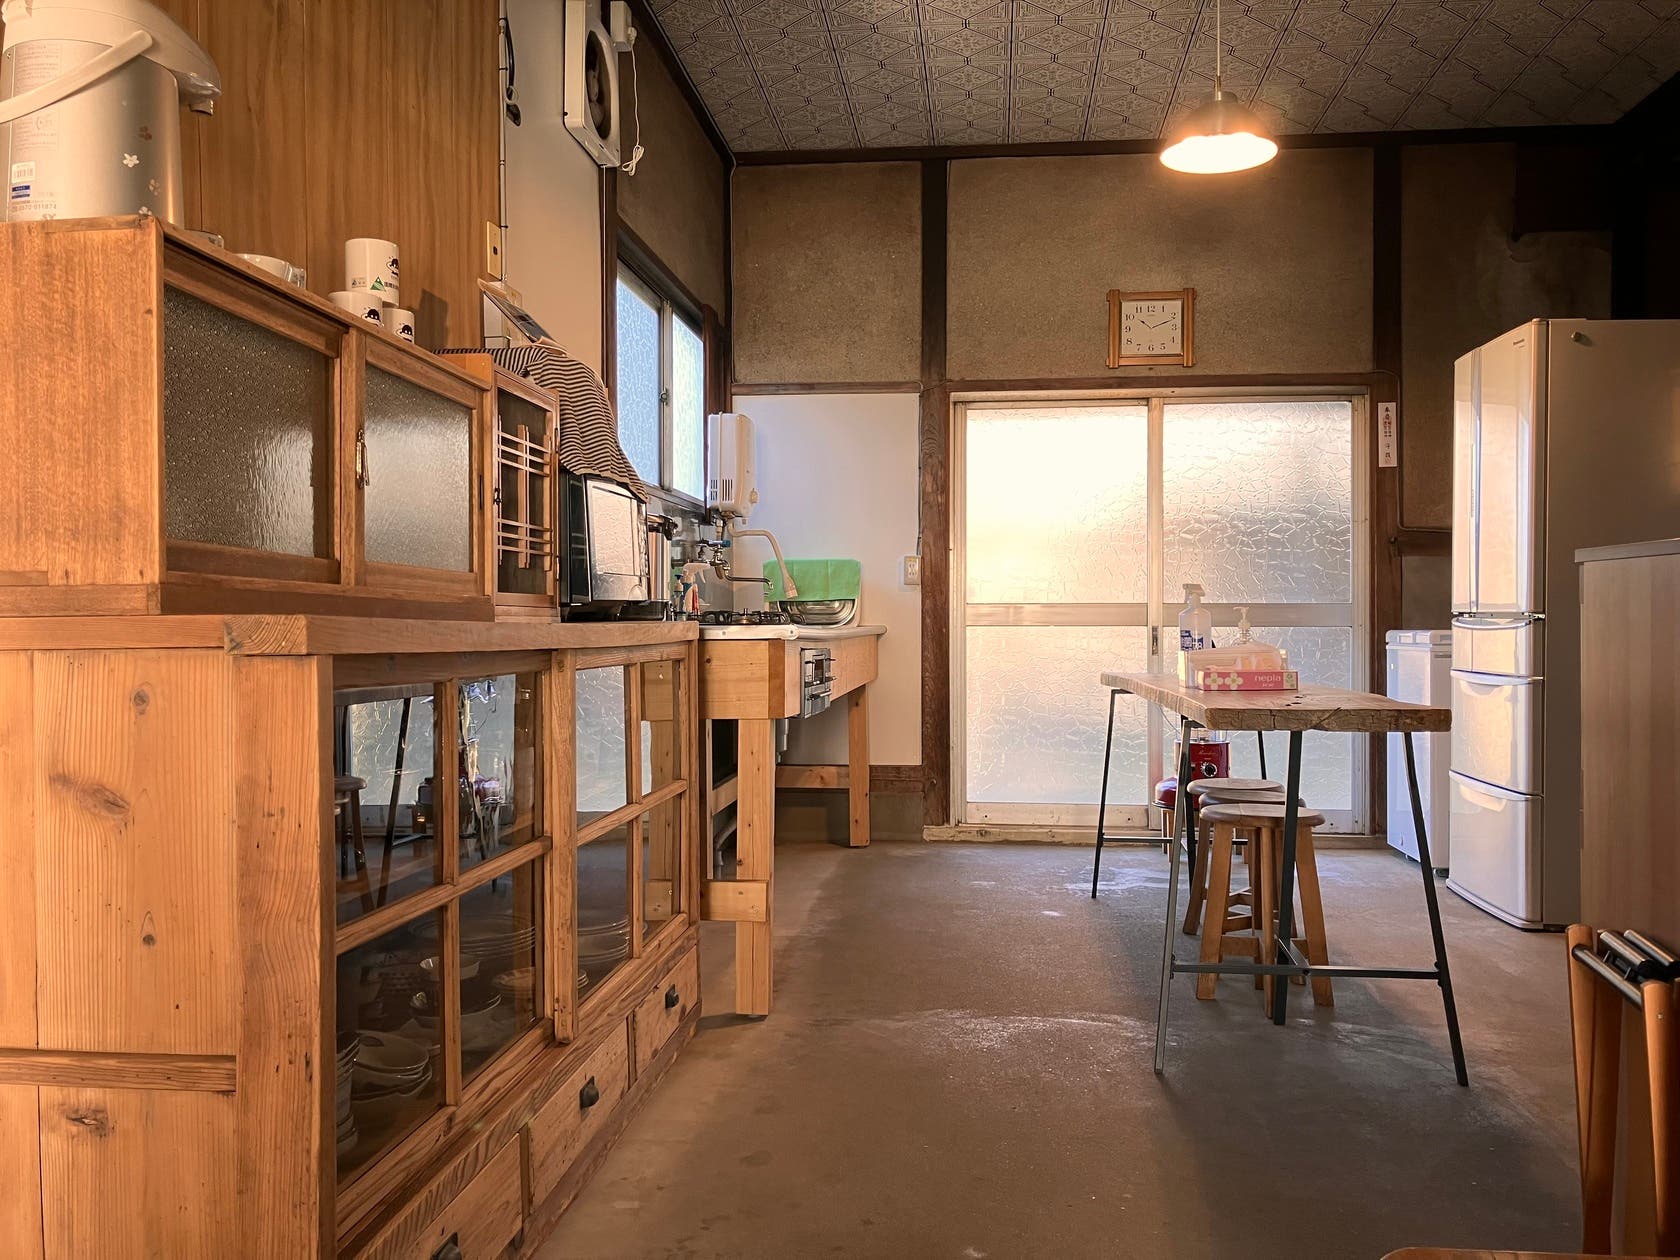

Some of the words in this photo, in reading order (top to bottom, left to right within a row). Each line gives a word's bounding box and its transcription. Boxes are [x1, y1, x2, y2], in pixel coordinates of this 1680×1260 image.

[1135, 305, 1142, 313] 11
[1147, 305, 1156, 313] 12
[1170, 312, 1176, 320] 2
[1124, 325, 1131, 333] 9
[1148, 344, 1154, 352] 6
